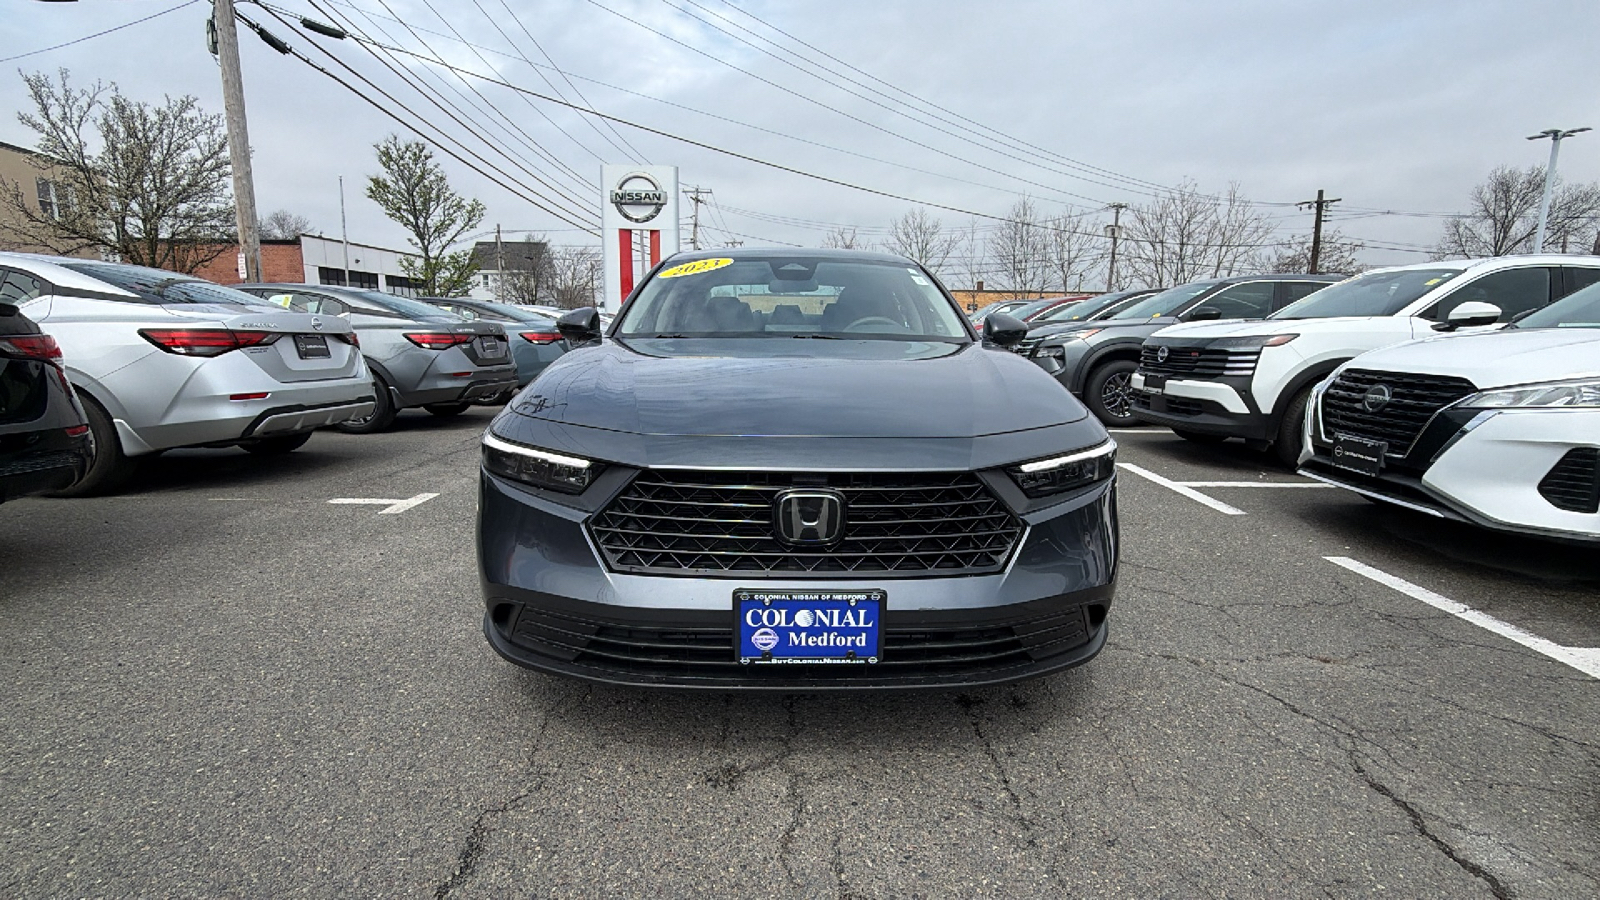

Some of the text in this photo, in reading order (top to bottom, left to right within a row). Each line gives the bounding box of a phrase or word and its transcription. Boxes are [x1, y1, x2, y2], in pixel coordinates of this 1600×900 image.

[614, 192, 661, 201] NISSAN
[673, 259, 720, 275] 2023
[746, 608, 873, 627] COLONIAL
[788, 632, 866, 646] Medford
